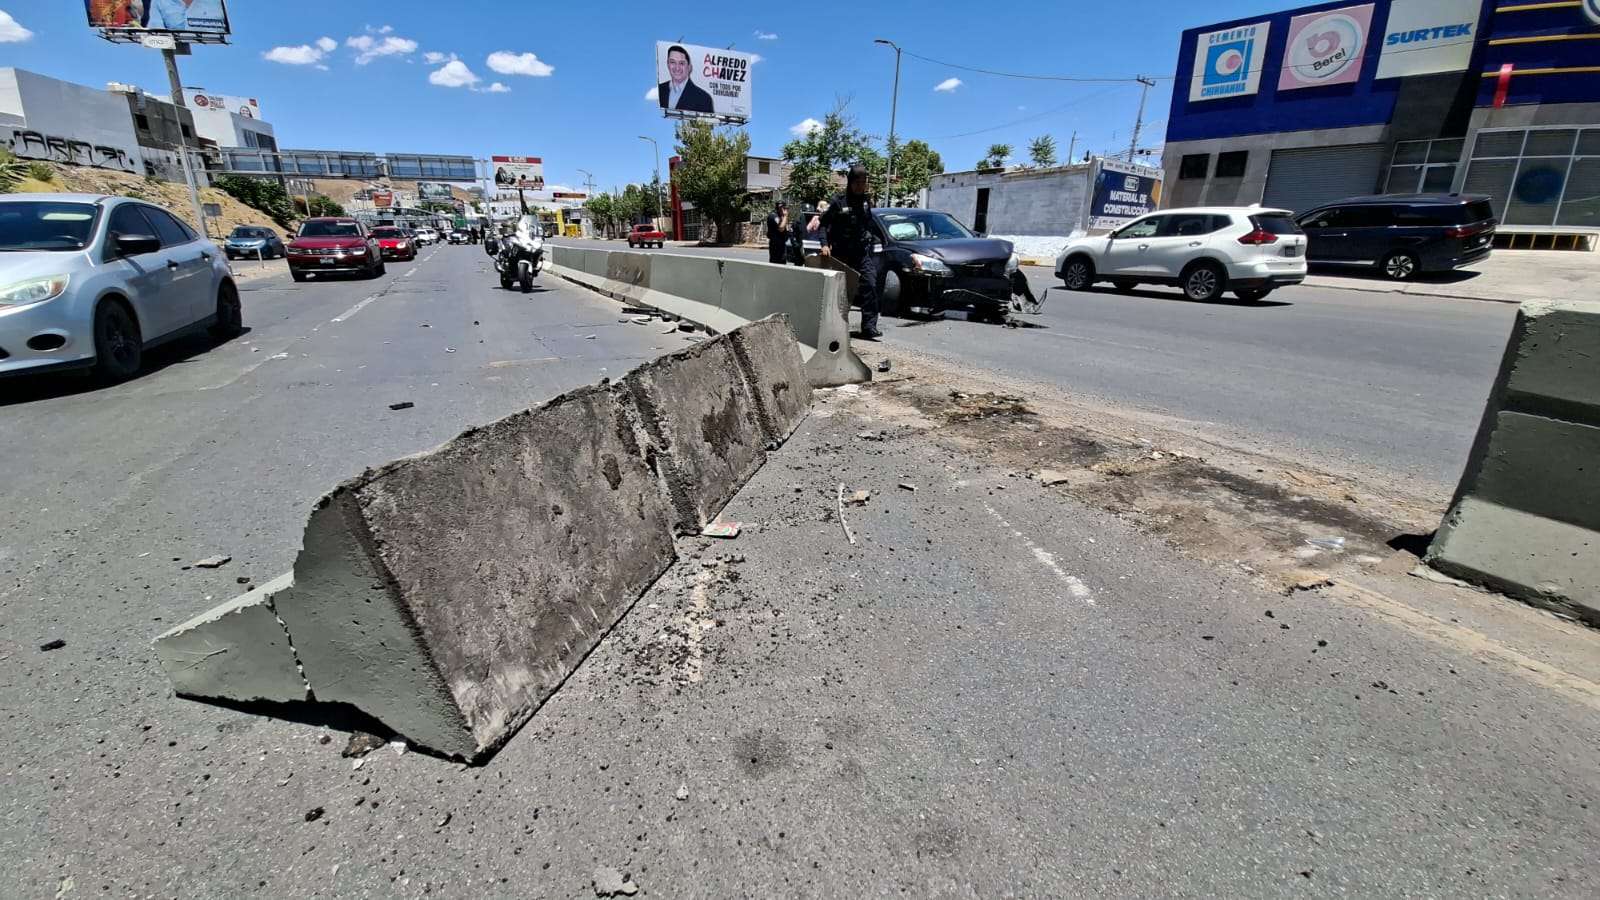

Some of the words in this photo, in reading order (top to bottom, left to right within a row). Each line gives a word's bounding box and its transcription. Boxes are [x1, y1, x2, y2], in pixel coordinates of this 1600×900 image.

[1209, 26, 1256, 43] CEMENTO
[1386, 22, 1473, 45] SURTEK
[703, 53, 747, 70] ALFREDO
[1313, 47, 1346, 70] Berel
[703, 66, 747, 82] CHAVEZ
[1201, 83, 1246, 97] CHIHUAHUA
[1110, 190, 1138, 203] MATERIAL
[1139, 194, 1147, 203] DE
